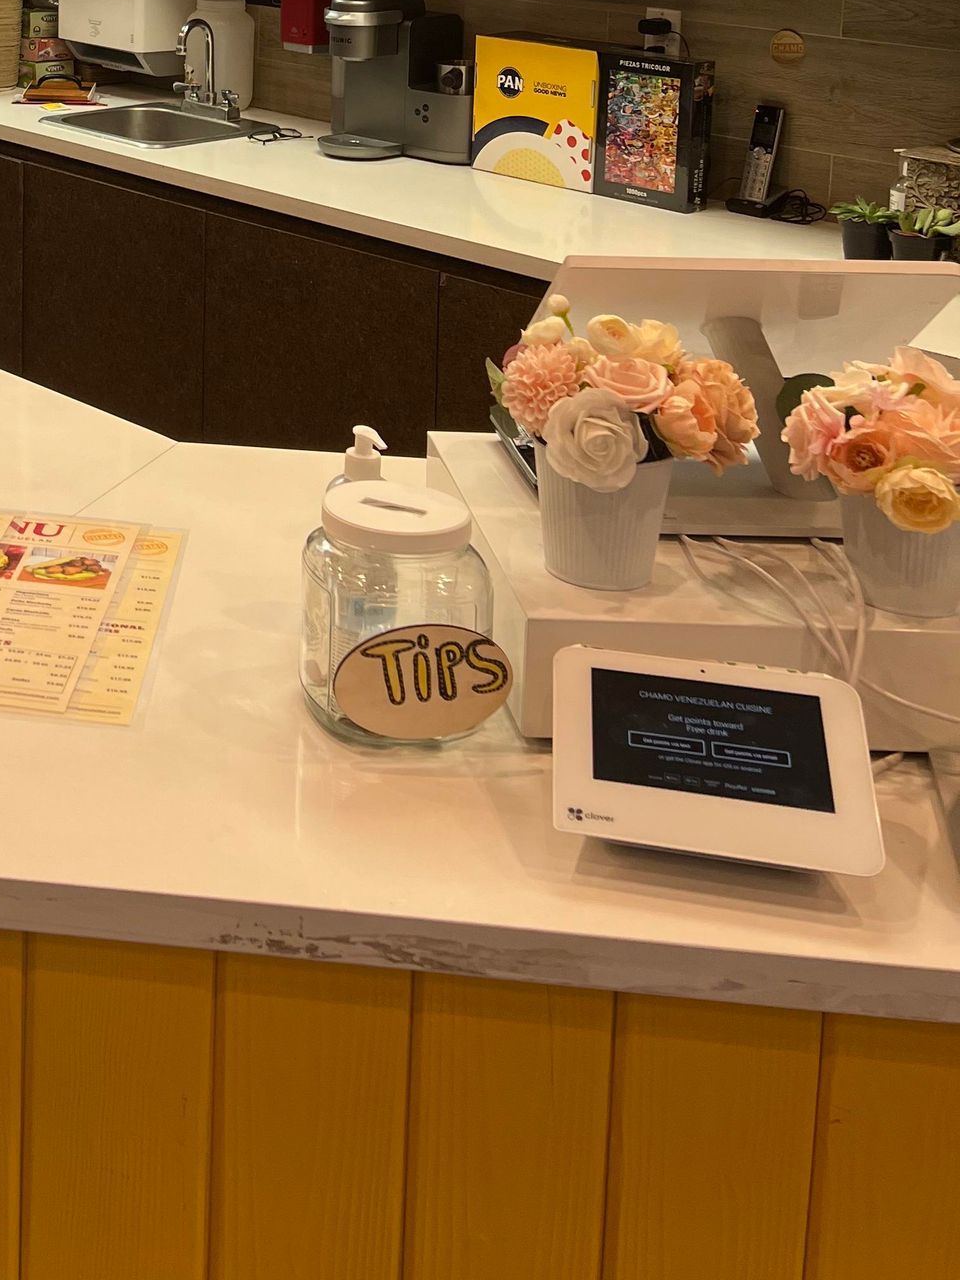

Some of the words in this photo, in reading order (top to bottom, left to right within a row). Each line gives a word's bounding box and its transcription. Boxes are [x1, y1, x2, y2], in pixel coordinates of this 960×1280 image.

[620, 60, 640, 68] PIEZAS
[642, 63, 670, 72] TRICOLOR
[497, 75, 524, 91] PAN
[534, 82, 567, 91] UNBOXING
[639, 690, 673, 702] CHAMO
[675, 695, 734, 710] VENEZUELAN
[737, 703, 773, 715] CUISINE
[713, 720, 744, 731] toward
